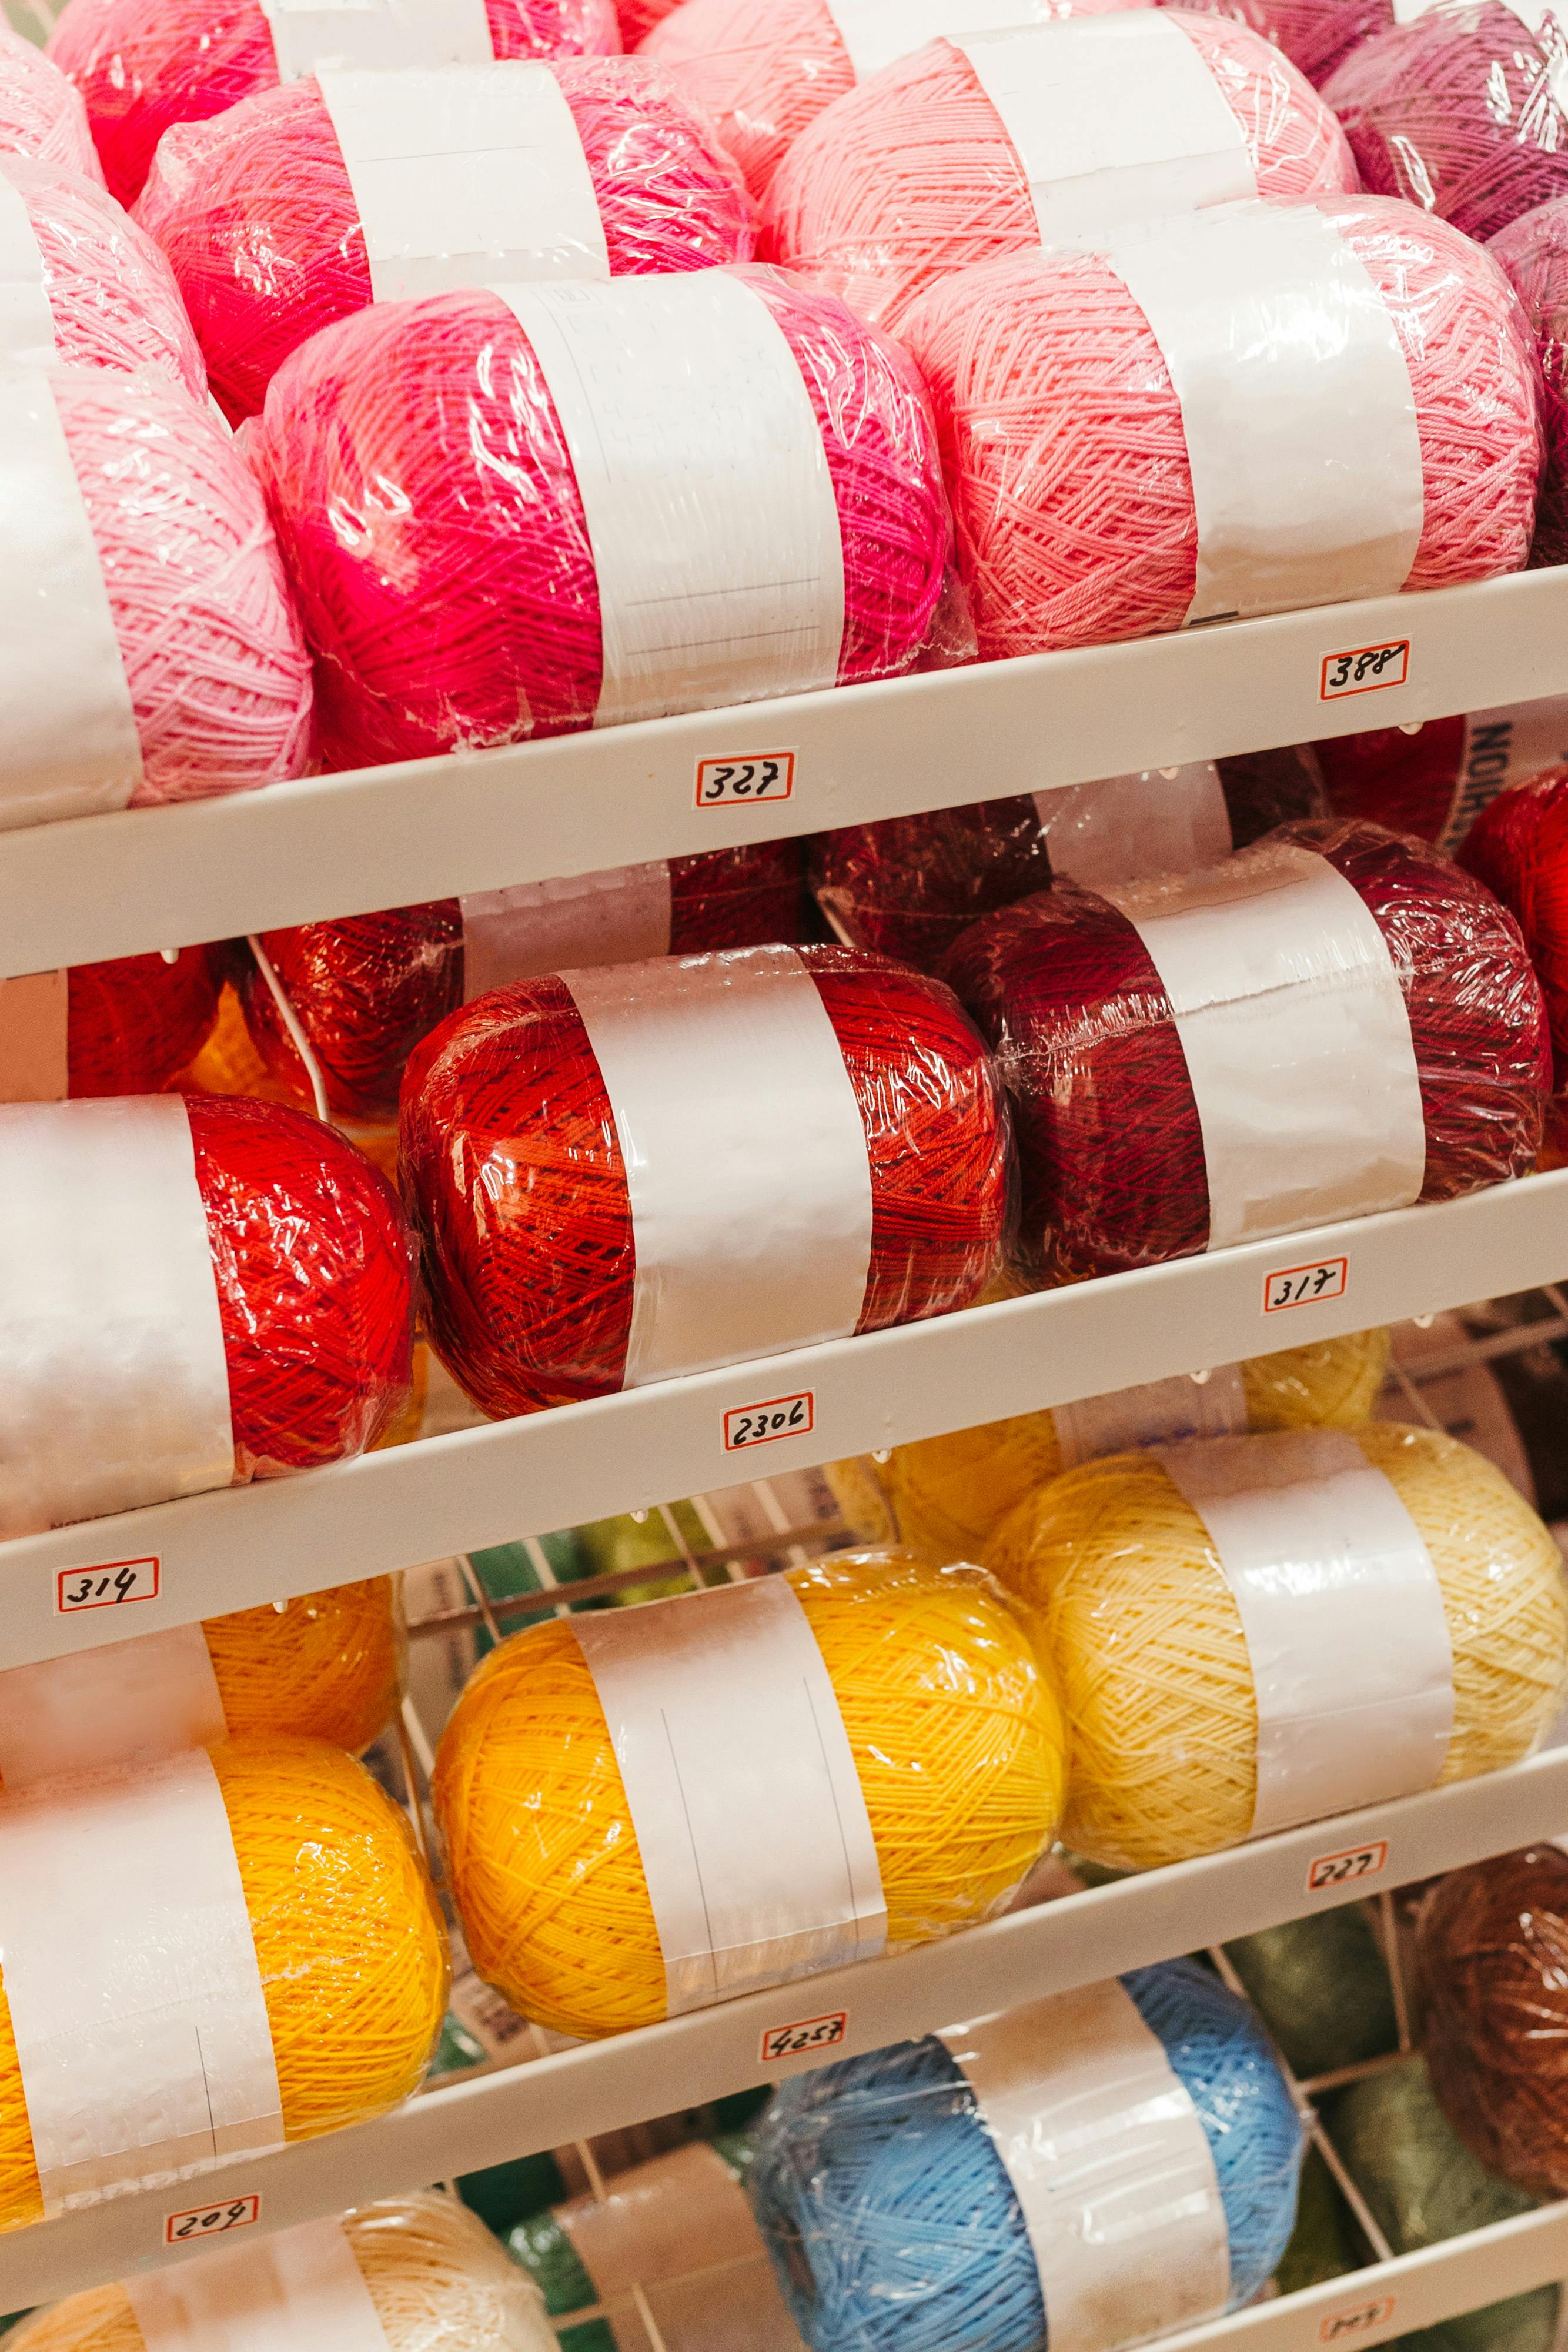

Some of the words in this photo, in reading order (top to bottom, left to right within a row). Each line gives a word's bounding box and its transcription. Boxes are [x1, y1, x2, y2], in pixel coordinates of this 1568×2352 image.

[1330, 644, 1405, 686] 388
[706, 762, 778, 798] 327
[1274, 1269, 1336, 1305] 317
[734, 1401, 804, 1445] 2306
[68, 1568, 136, 1603] 314
[771, 2022, 842, 2054] 4257
